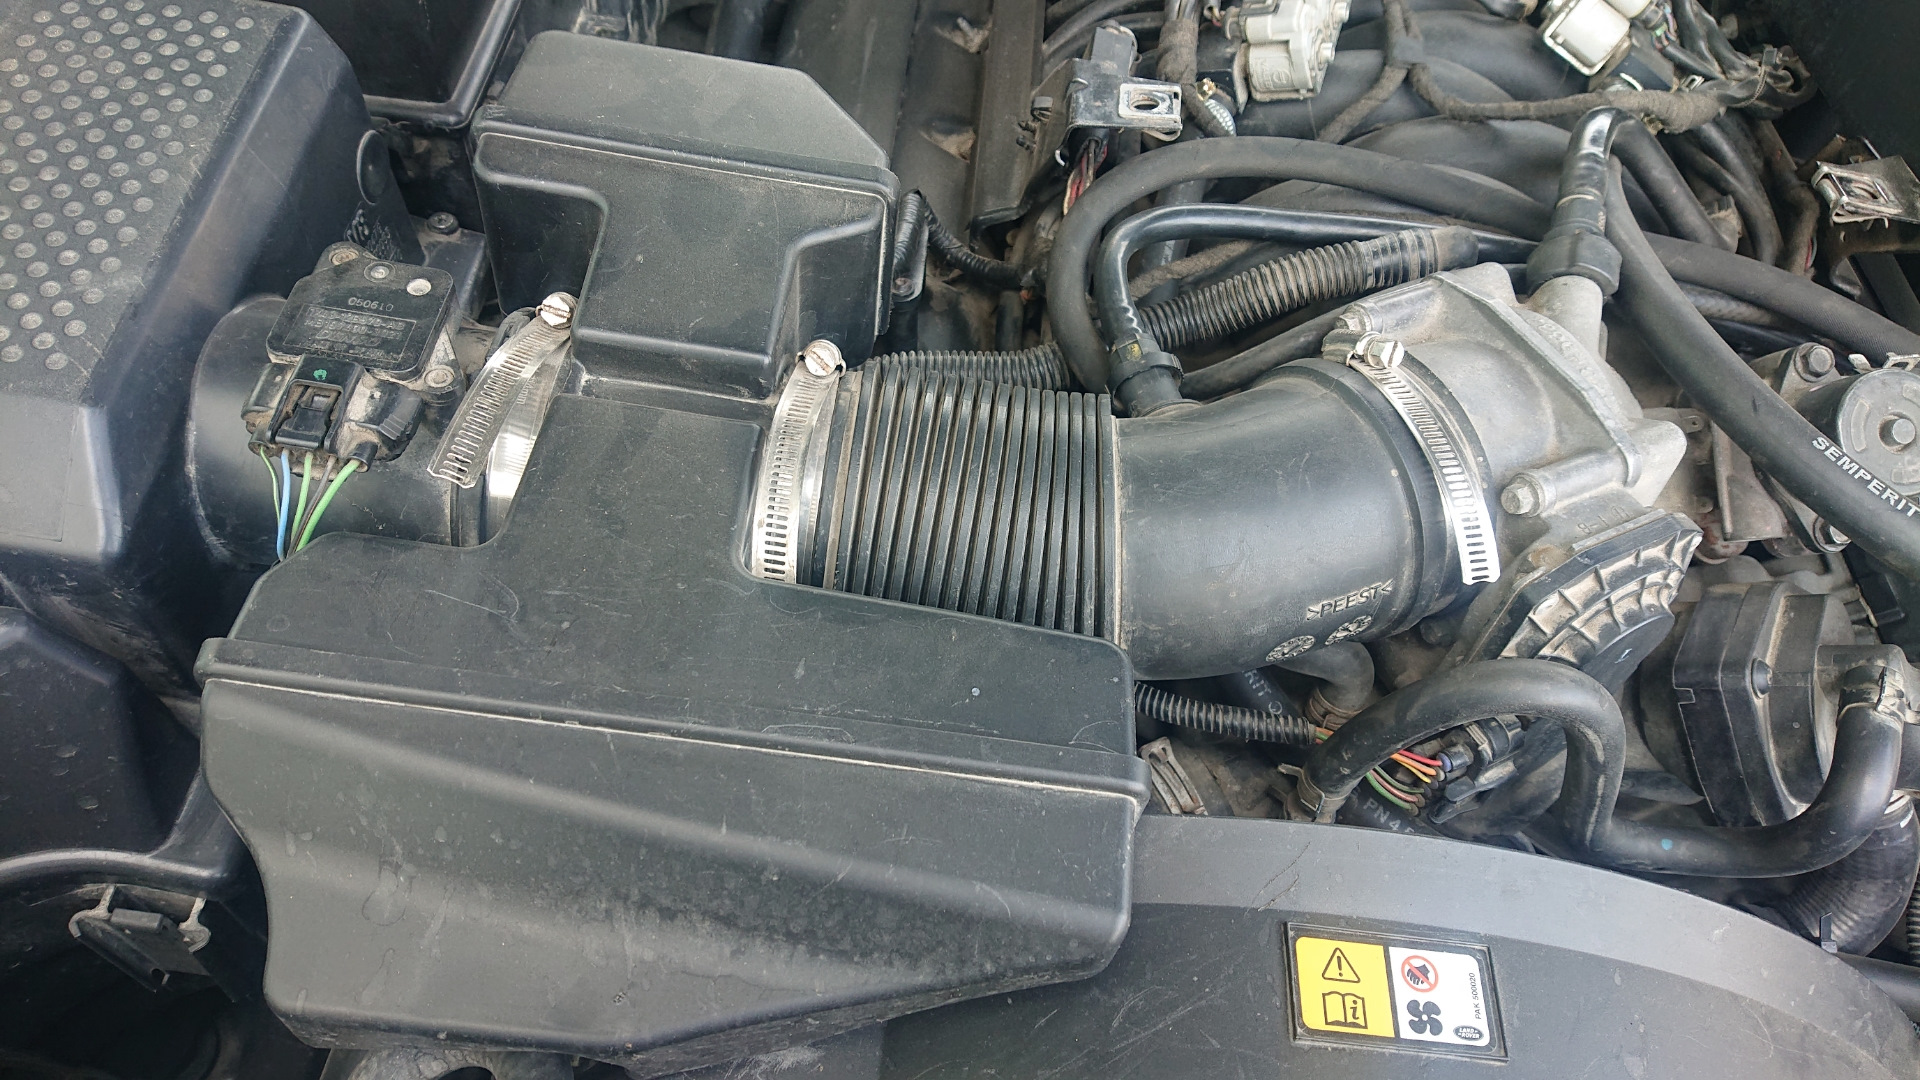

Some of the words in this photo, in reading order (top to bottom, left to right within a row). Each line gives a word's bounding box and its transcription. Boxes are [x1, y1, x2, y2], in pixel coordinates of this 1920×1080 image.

[348, 297, 394, 312] 050610
[1812, 436, 1920, 517] SEMPERIT
[1242, 669, 1271, 696] RIT
[1473, 1002, 1482, 1020] PAK
